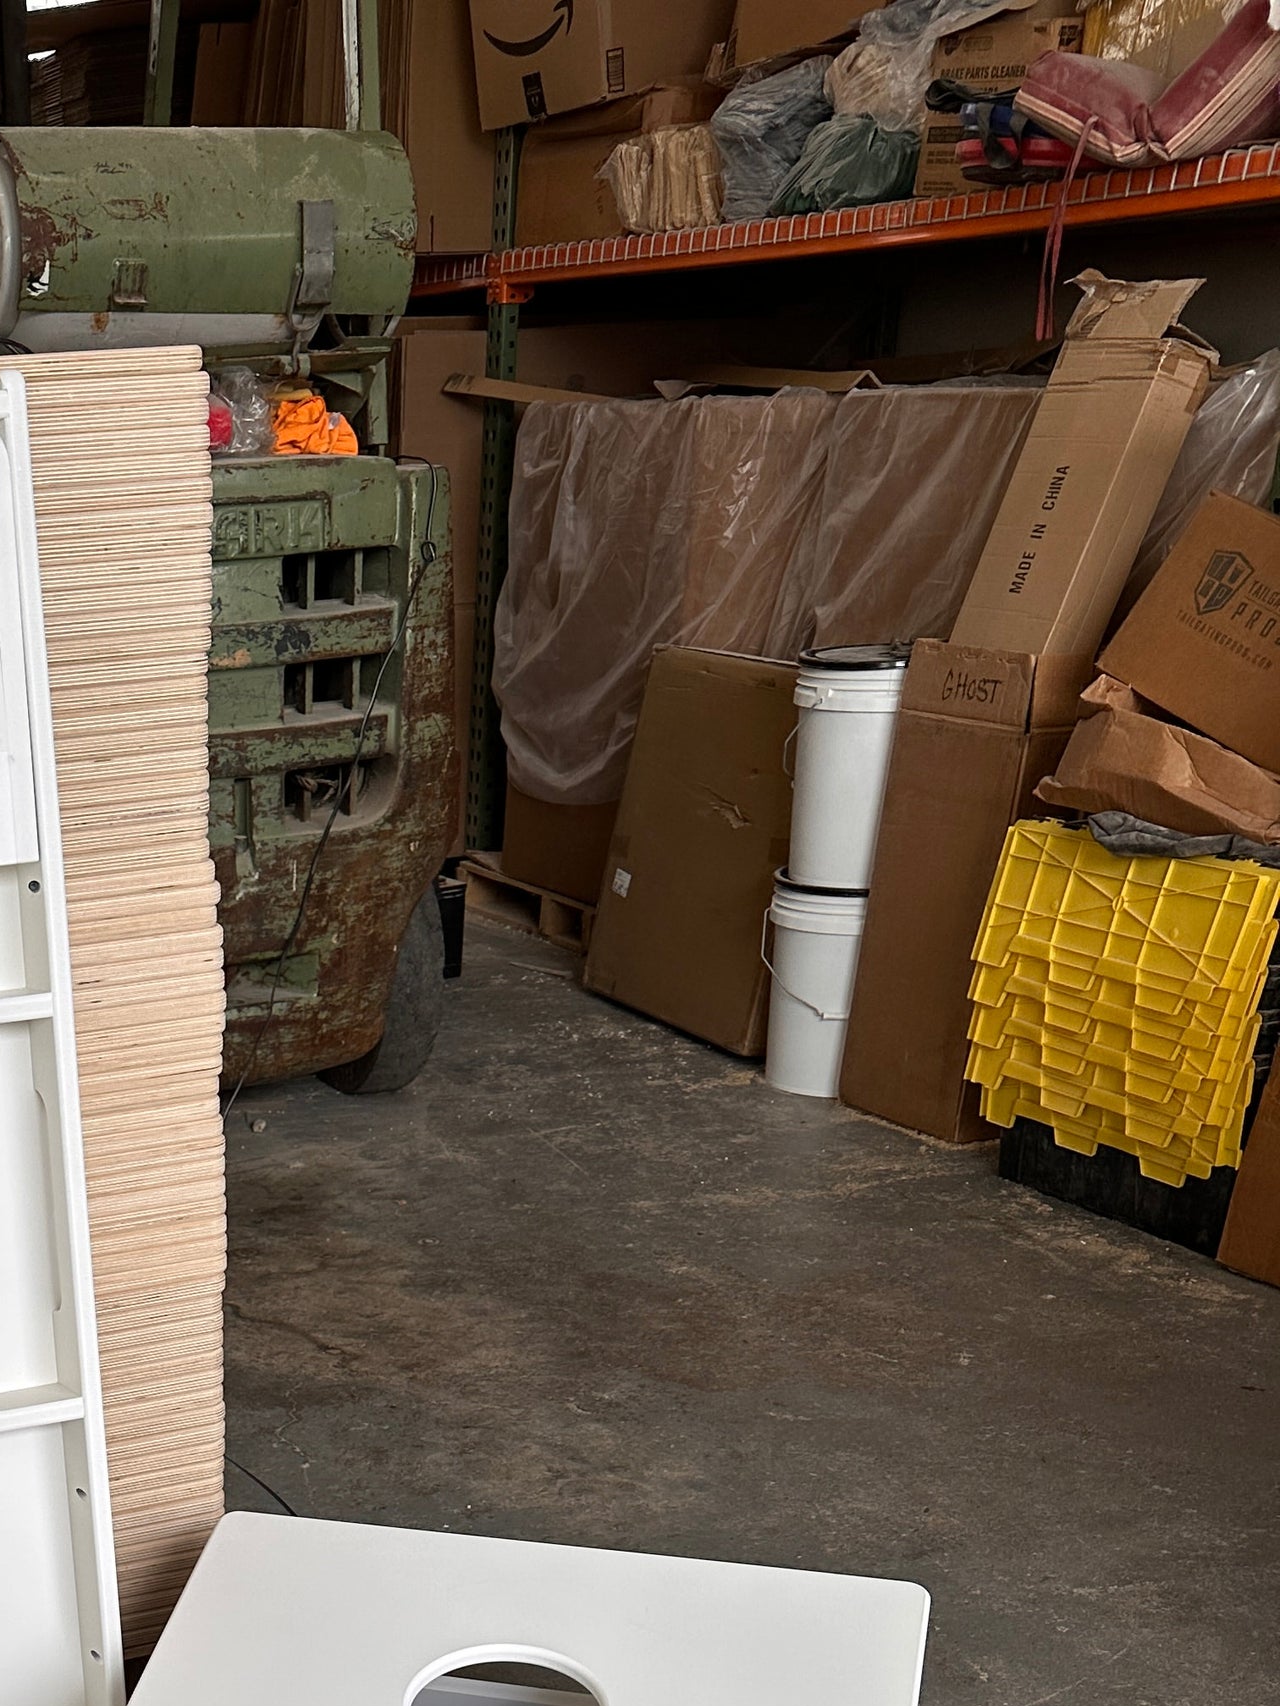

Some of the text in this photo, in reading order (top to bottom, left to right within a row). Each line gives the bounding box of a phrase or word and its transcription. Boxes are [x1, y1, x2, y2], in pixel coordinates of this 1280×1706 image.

[965, 66, 989, 79] PARTS
[991, 65, 1026, 79] CLEANER
[1009, 465, 1070, 594] MADE IN CHINA
[942, 668, 1002, 703] GHOST
